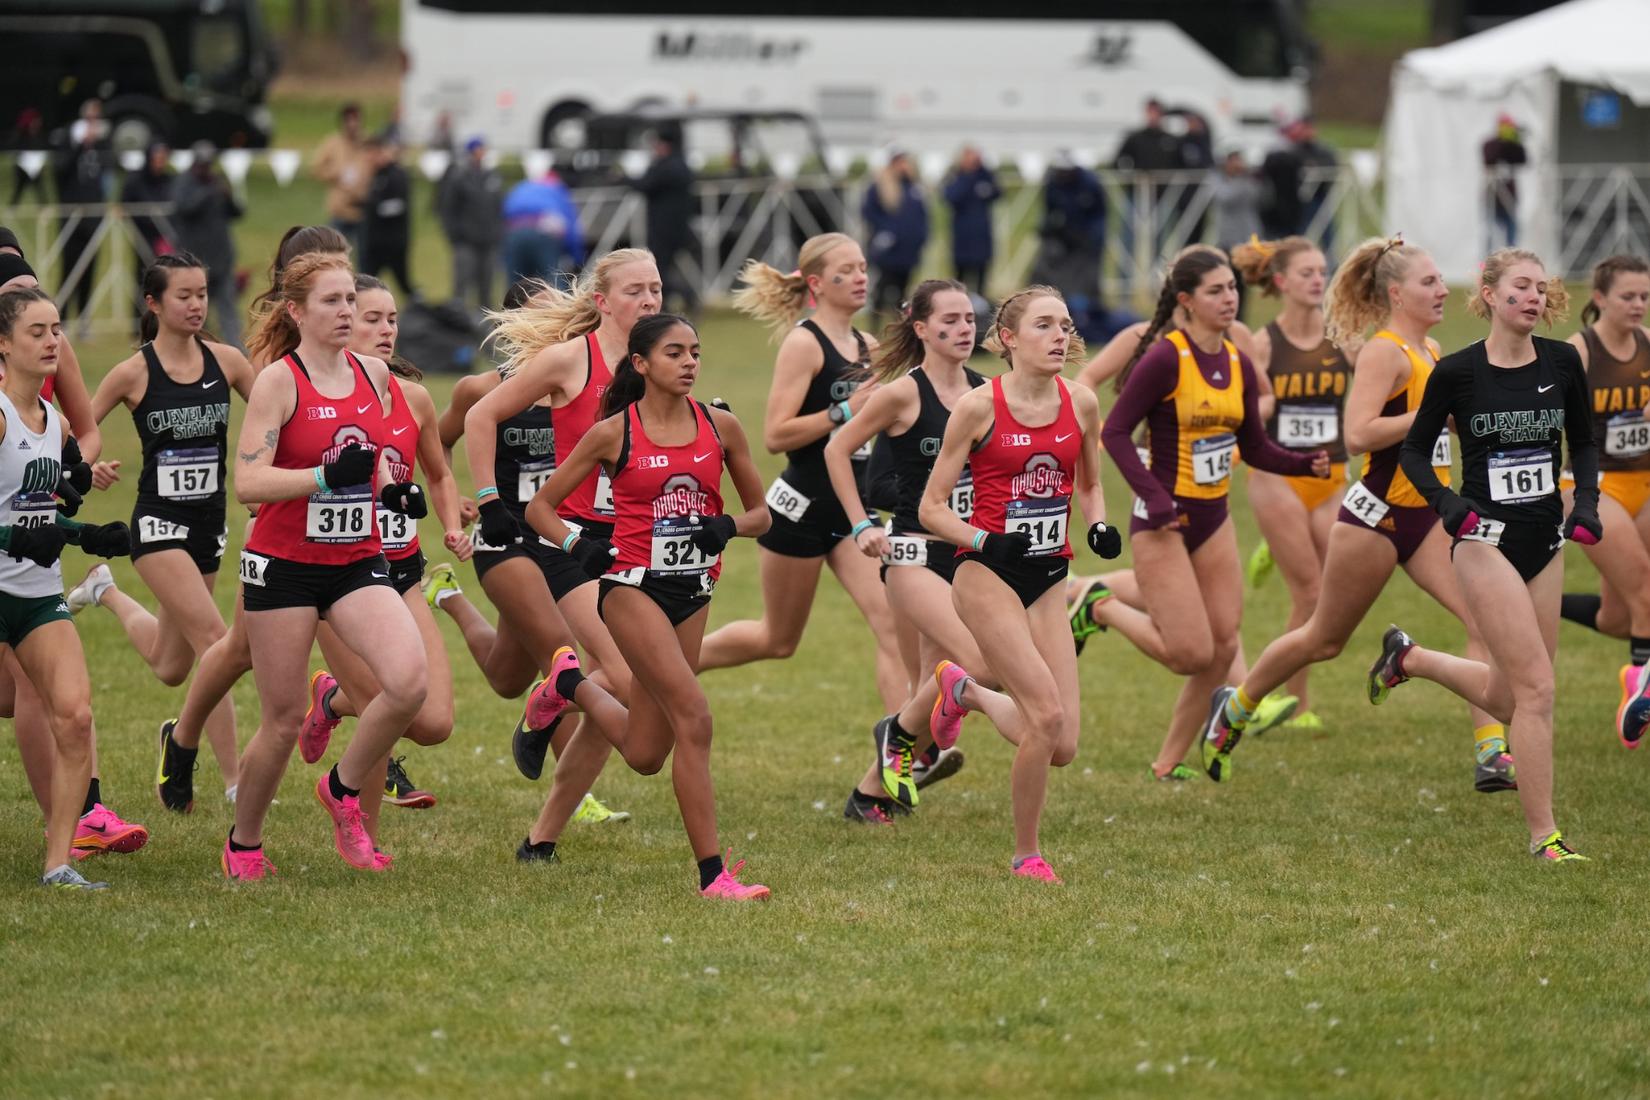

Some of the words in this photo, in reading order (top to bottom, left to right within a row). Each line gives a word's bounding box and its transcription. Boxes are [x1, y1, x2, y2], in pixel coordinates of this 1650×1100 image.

[1274, 371, 1346, 400] VALPO
[1594, 385, 1650, 413] VALP
[147, 403, 229, 434] CLEVELAN
[173, 421, 216, 440] STATE
[1289, 418, 1324, 437] 351
[1471, 409, 1565, 437] CLEVELAN
[1500, 426, 1550, 444] STATE
[1615, 428, 1648, 450] 348
[169, 468, 210, 491] 157
[1501, 468, 1544, 494] 161
[771, 486, 799, 512] 160
[1347, 489, 1377, 517] 141
[147, 520, 180, 537] 157
[318, 508, 363, 533] 318
[379, 514, 407, 539] 13
[240, 558, 258, 580] 18
